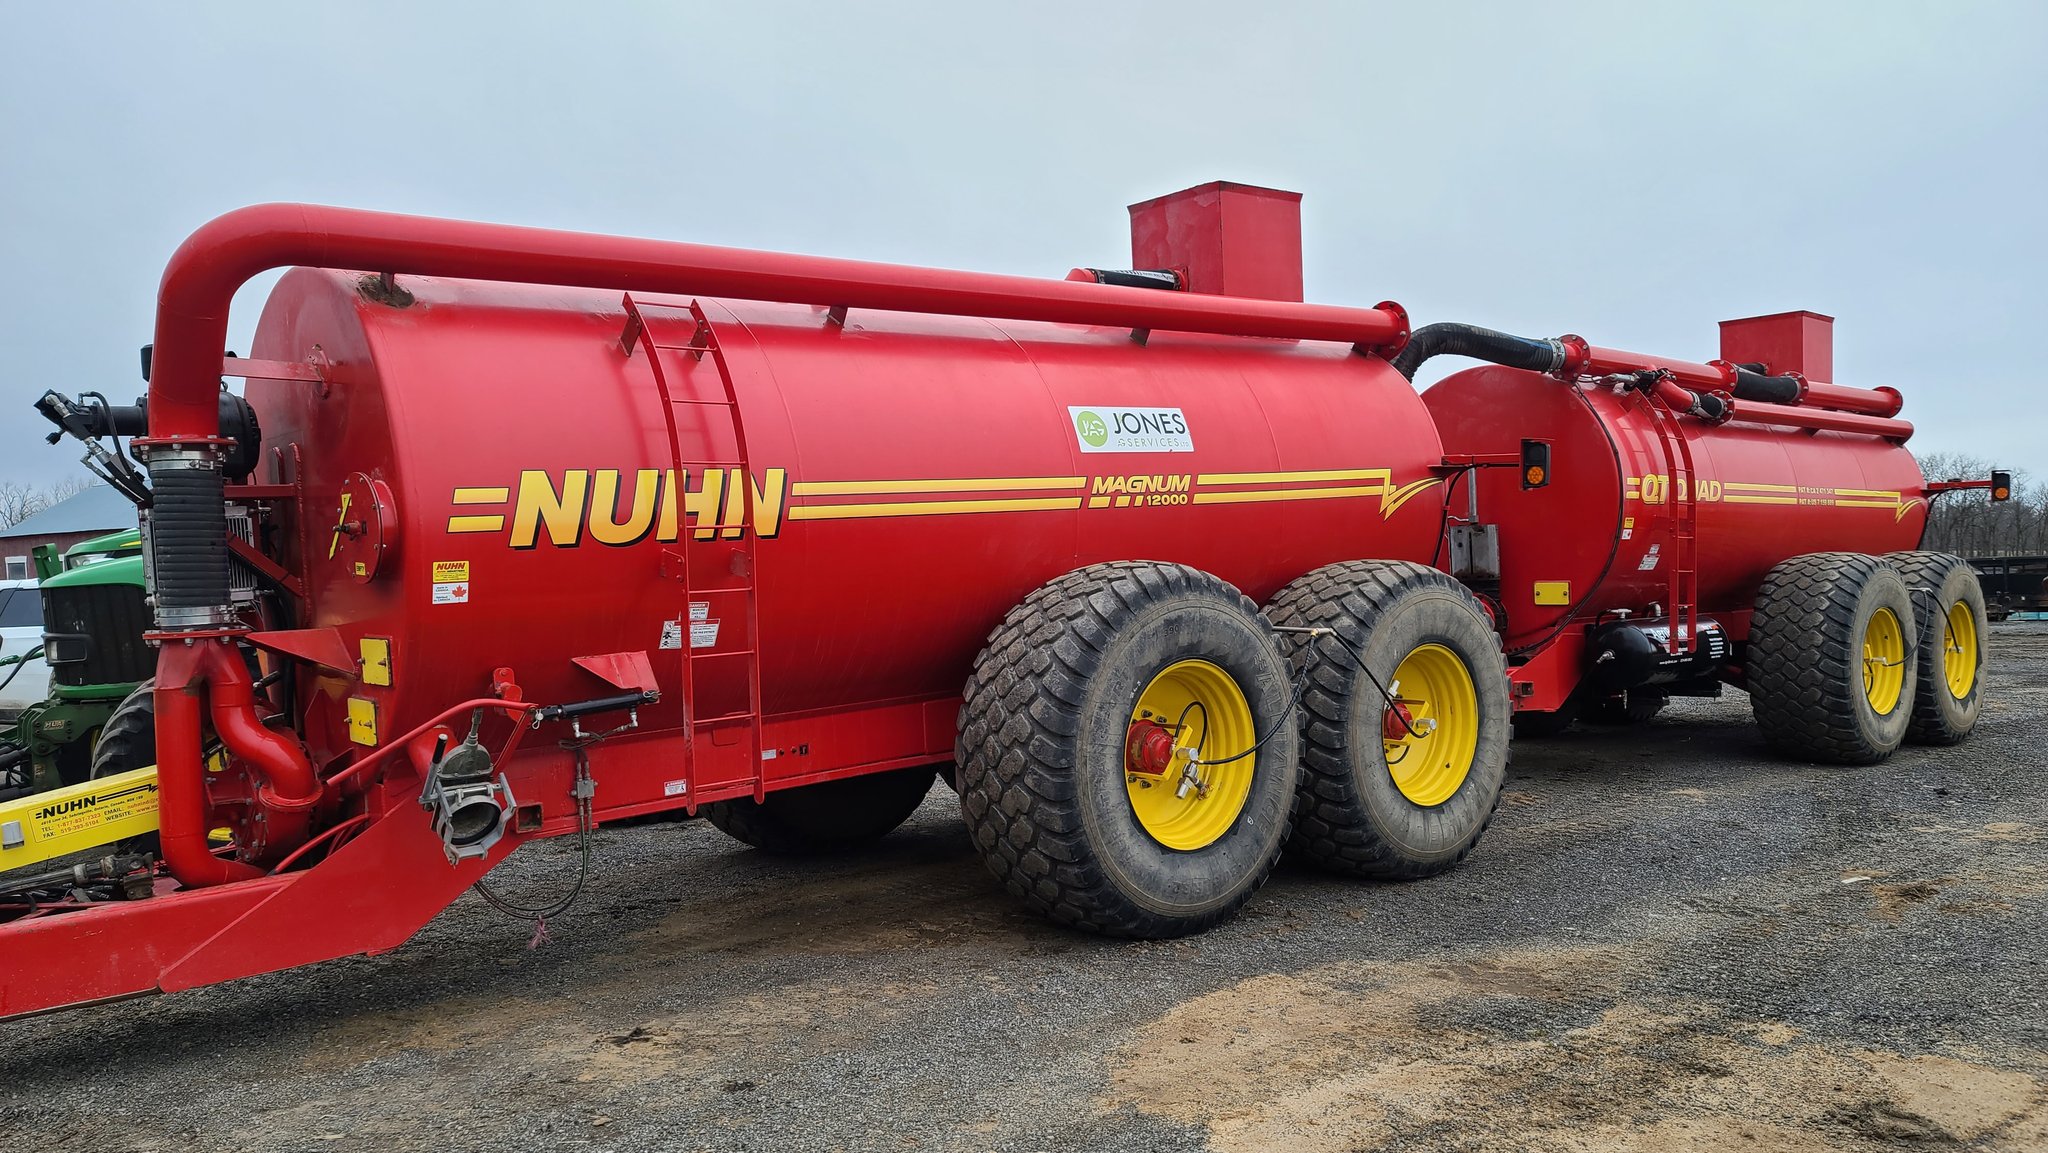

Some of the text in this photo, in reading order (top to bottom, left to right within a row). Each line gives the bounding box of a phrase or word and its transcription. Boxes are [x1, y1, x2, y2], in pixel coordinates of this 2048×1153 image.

[1113, 412, 1186, 435] JONES
[1127, 438, 1180, 447] SERVICES
[1091, 474, 1192, 494] MAGNUM
[1676, 479, 1722, 502] QAD
[1146, 493, 1189, 506] 12000
[508, 468, 788, 550] NUHN
[436, 562, 466, 570] NUHN
[43, 795, 96, 818] NUHN
[103, 807, 124, 815] EMAIL:
[105, 810, 133, 821] WEBSITE:
[42, 830, 56, 838] FAX:
